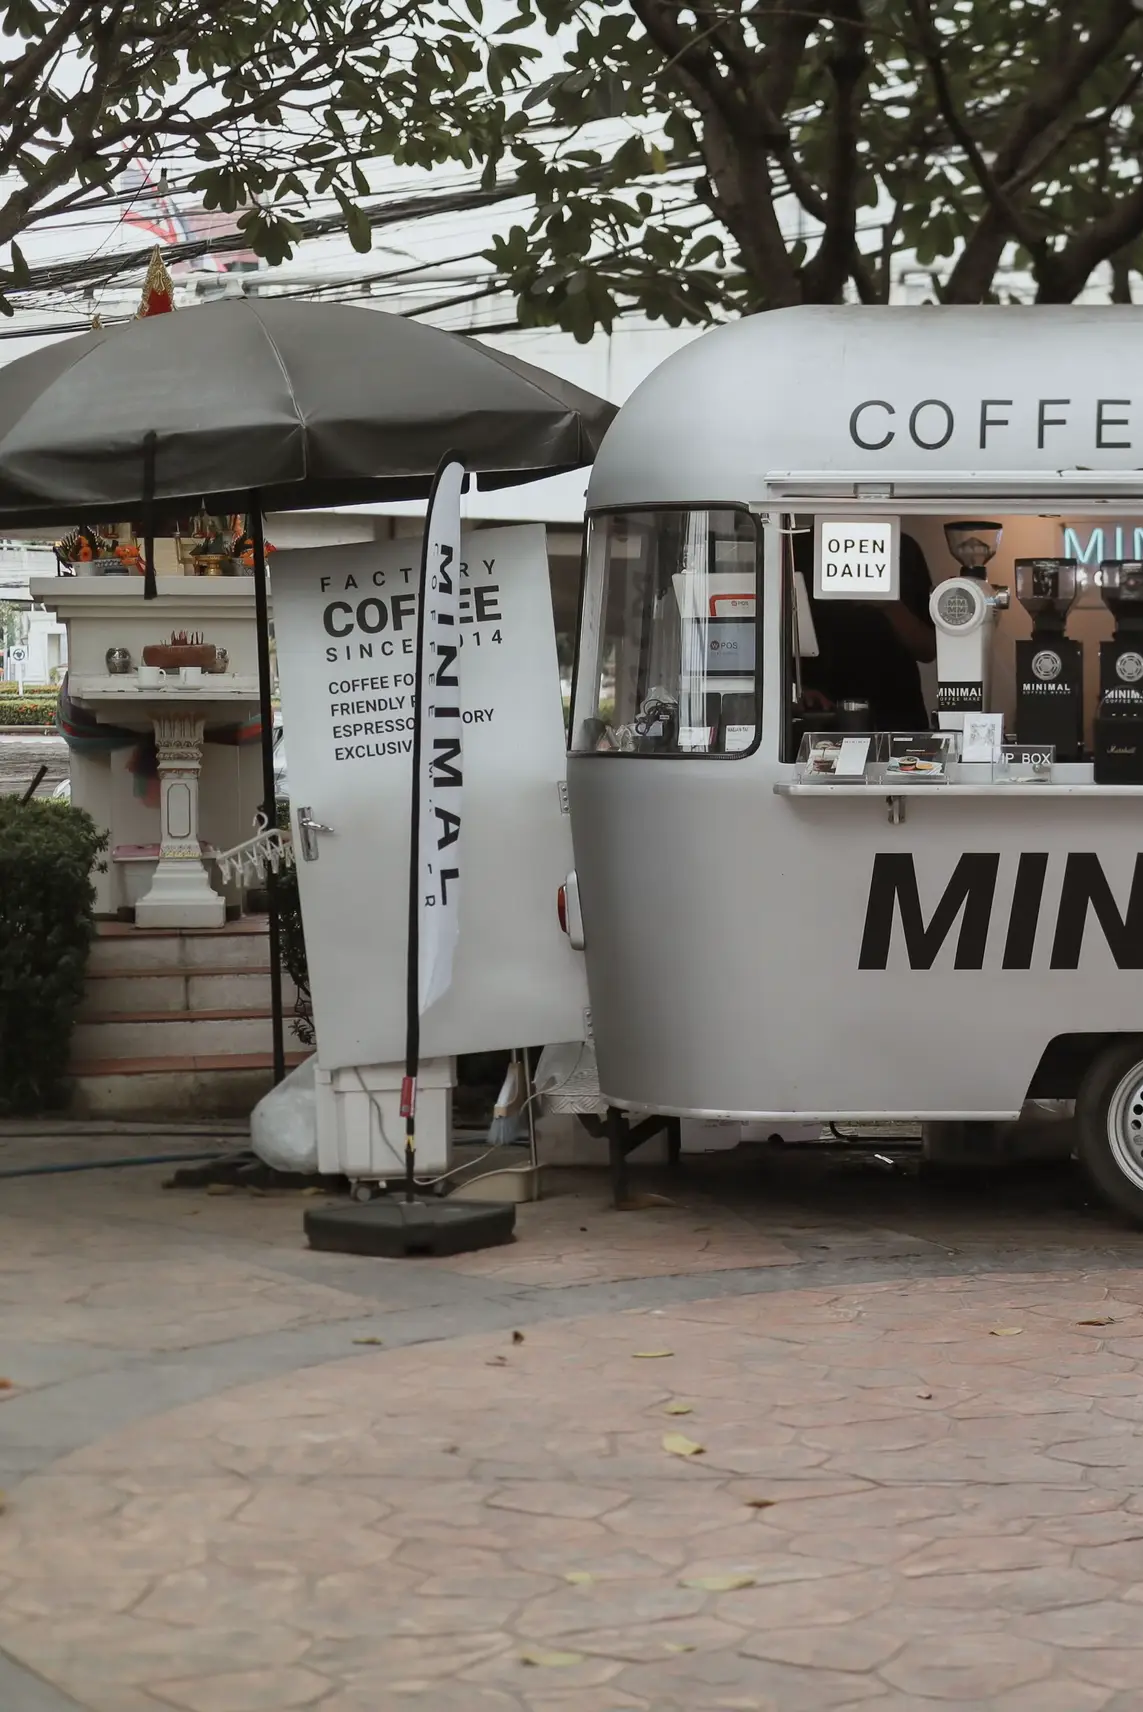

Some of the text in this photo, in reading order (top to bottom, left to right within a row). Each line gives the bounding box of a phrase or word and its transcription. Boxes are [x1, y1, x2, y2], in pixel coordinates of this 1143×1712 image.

[828, 539, 885, 554] OPEN
[320, 559, 496, 593] FACTRY
[826, 563, 886, 578] DAILY
[323, 585, 502, 637] COFEE
[326, 639, 414, 662] SINCE
[721, 641, 738, 650] POS
[328, 673, 416, 695] COFFEE FO
[1022, 683, 1071, 691] MINIMAL
[330, 696, 405, 717] FRIENDLY
[333, 718, 416, 739] ESPRESSO
[433, 544, 463, 906] MINIMAL
[335, 740, 413, 761] EXCLUSIV
[1022, 753, 1052, 764] BOX
